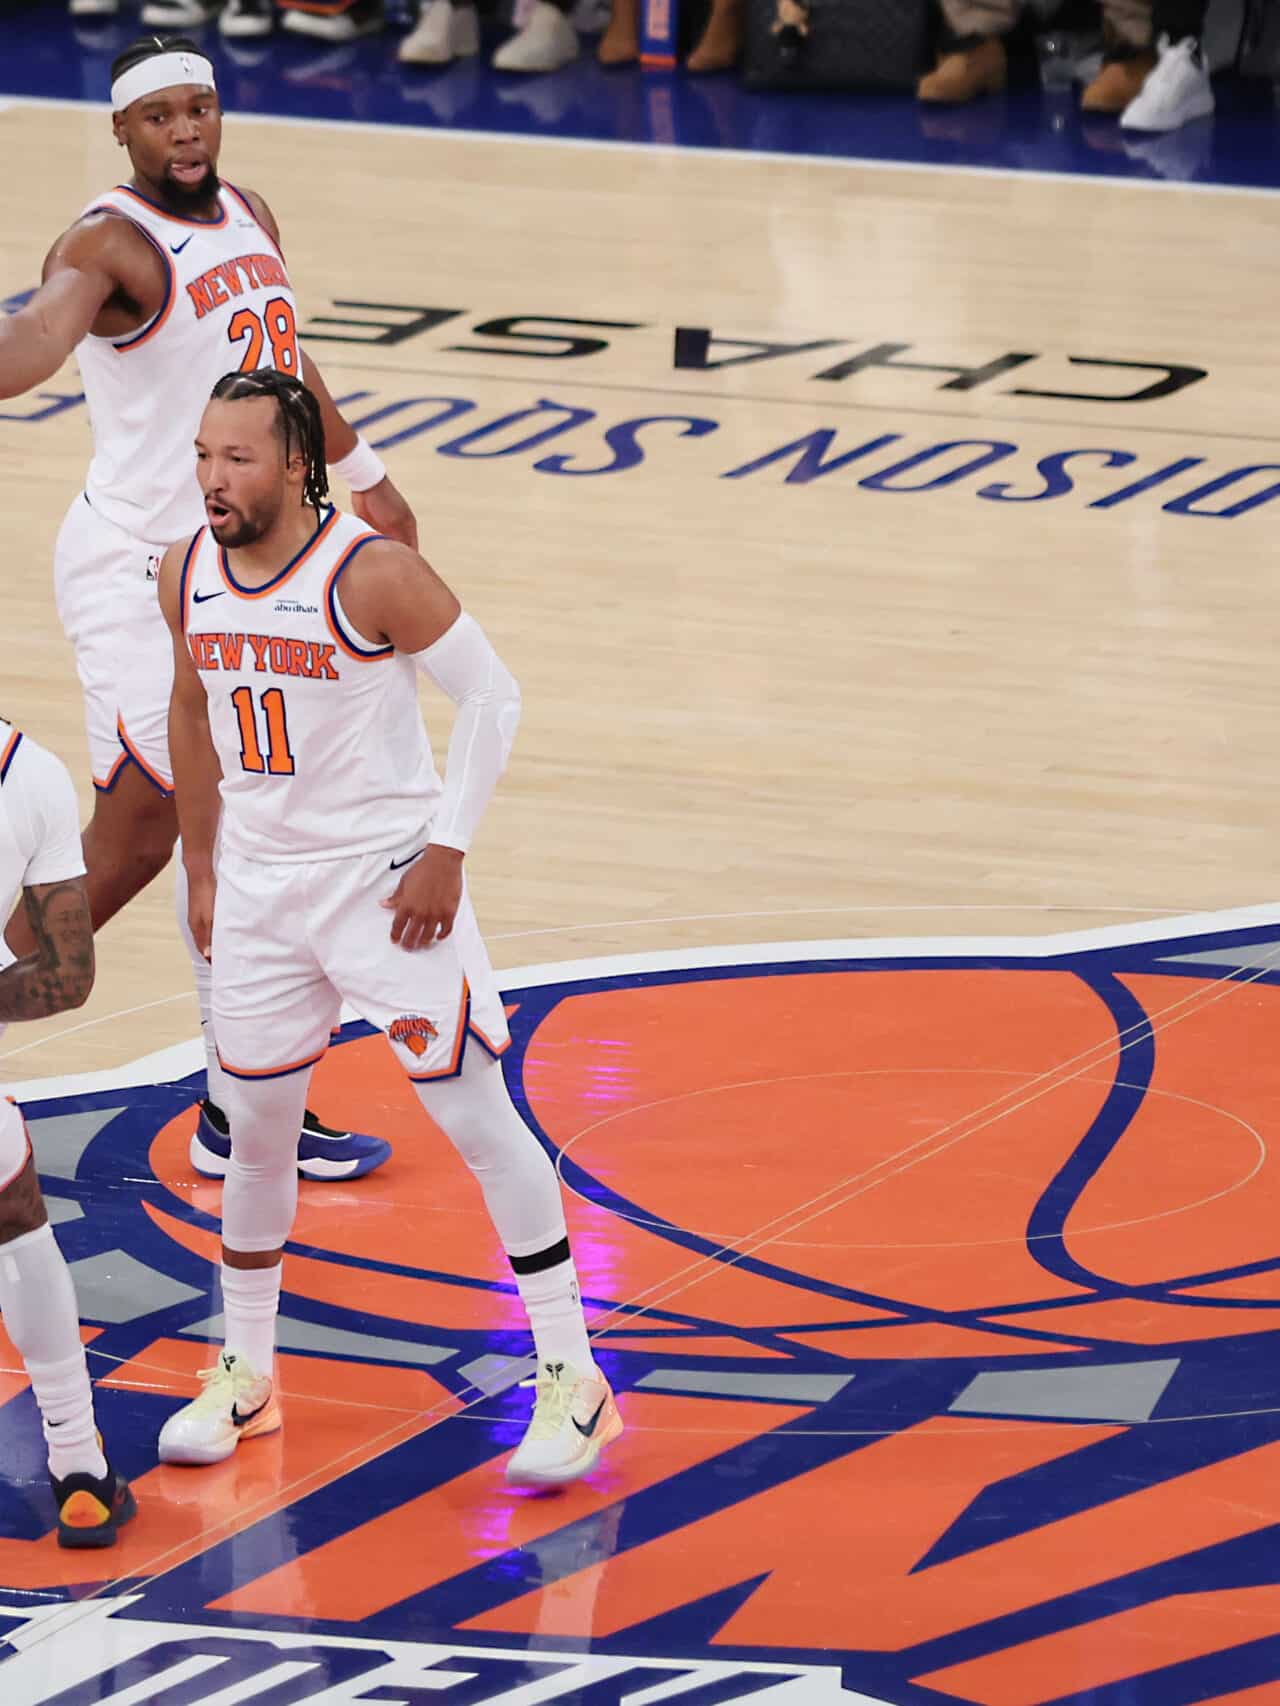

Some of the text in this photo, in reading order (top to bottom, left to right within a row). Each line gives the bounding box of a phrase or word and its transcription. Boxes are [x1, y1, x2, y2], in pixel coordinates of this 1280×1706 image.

[185, 253, 293, 320] NEW YOR
[227, 296, 298, 378] 28
[294, 299, 1210, 402] CHASE
[187, 632, 339, 681] NEW YORK
[230, 686, 295, 776] 11
